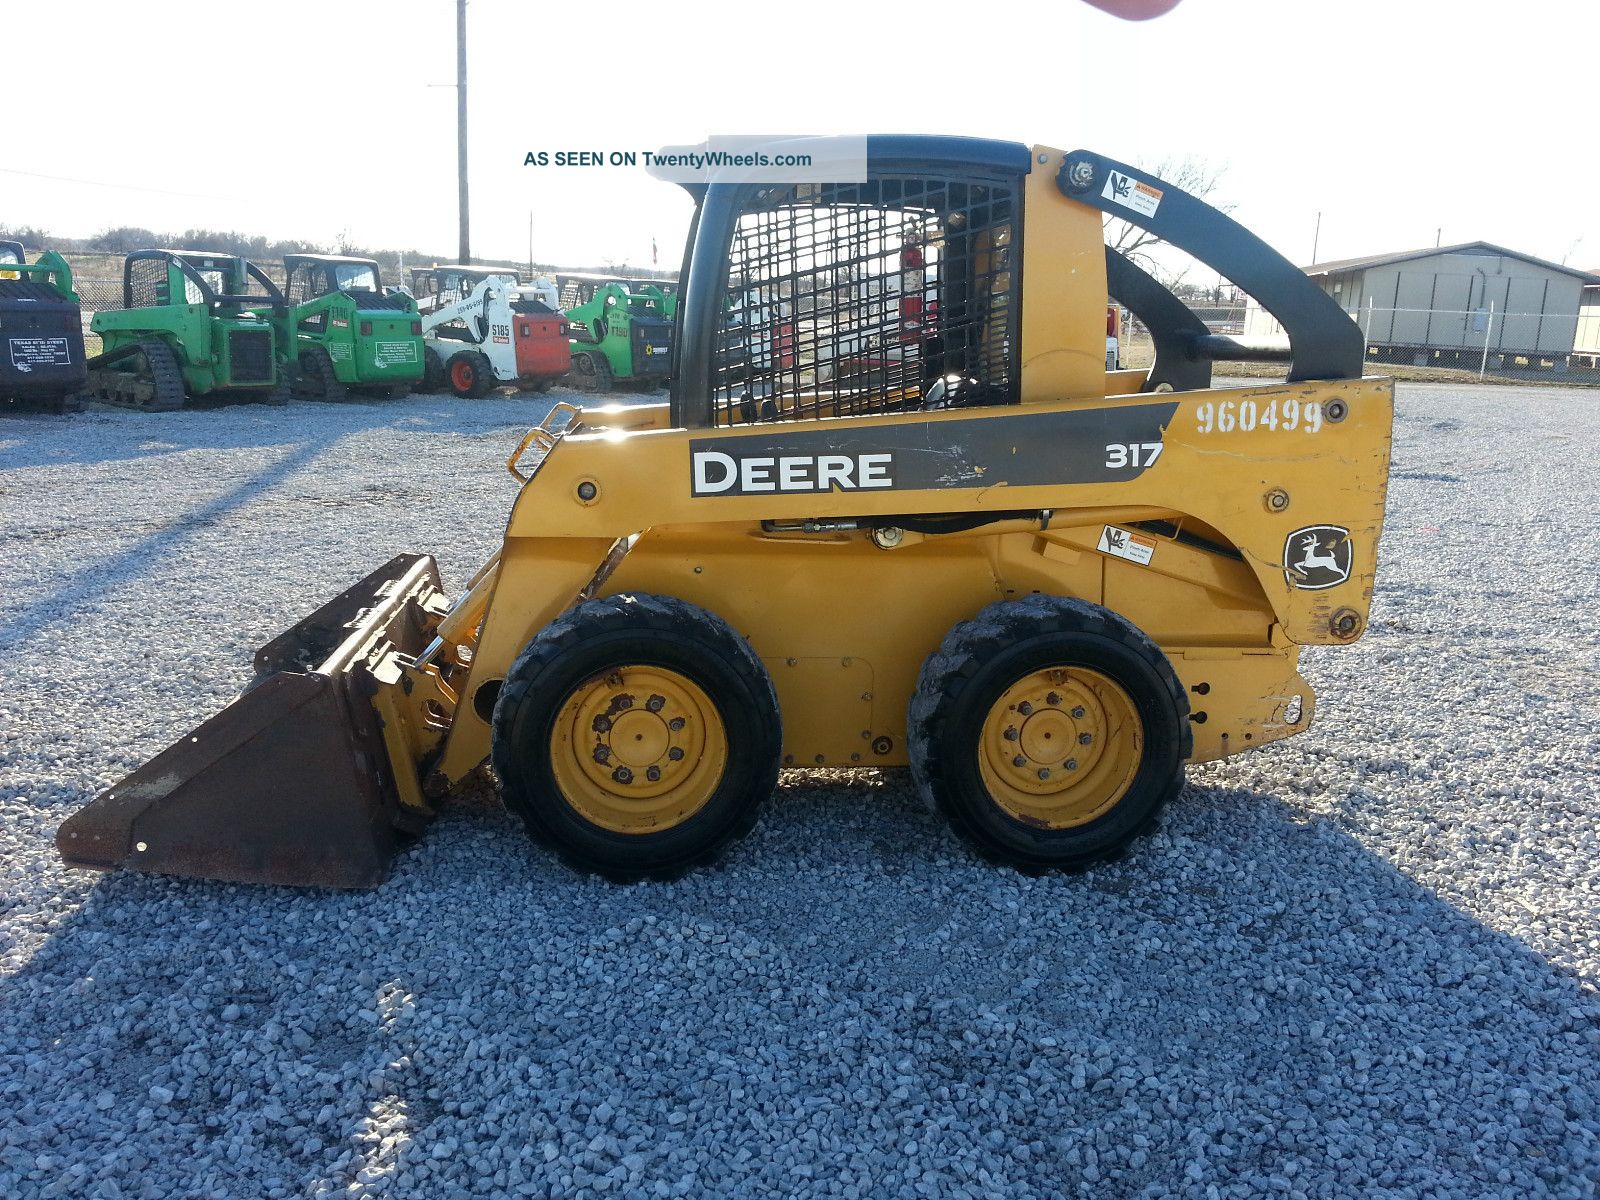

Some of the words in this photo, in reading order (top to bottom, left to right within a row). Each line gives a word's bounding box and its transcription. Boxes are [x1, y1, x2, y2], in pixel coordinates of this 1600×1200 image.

[492, 325, 510, 336] S185
[1196, 399, 1323, 433] 960499
[693, 452, 892, 493] DEERE
[1105, 442, 1164, 469] 317
